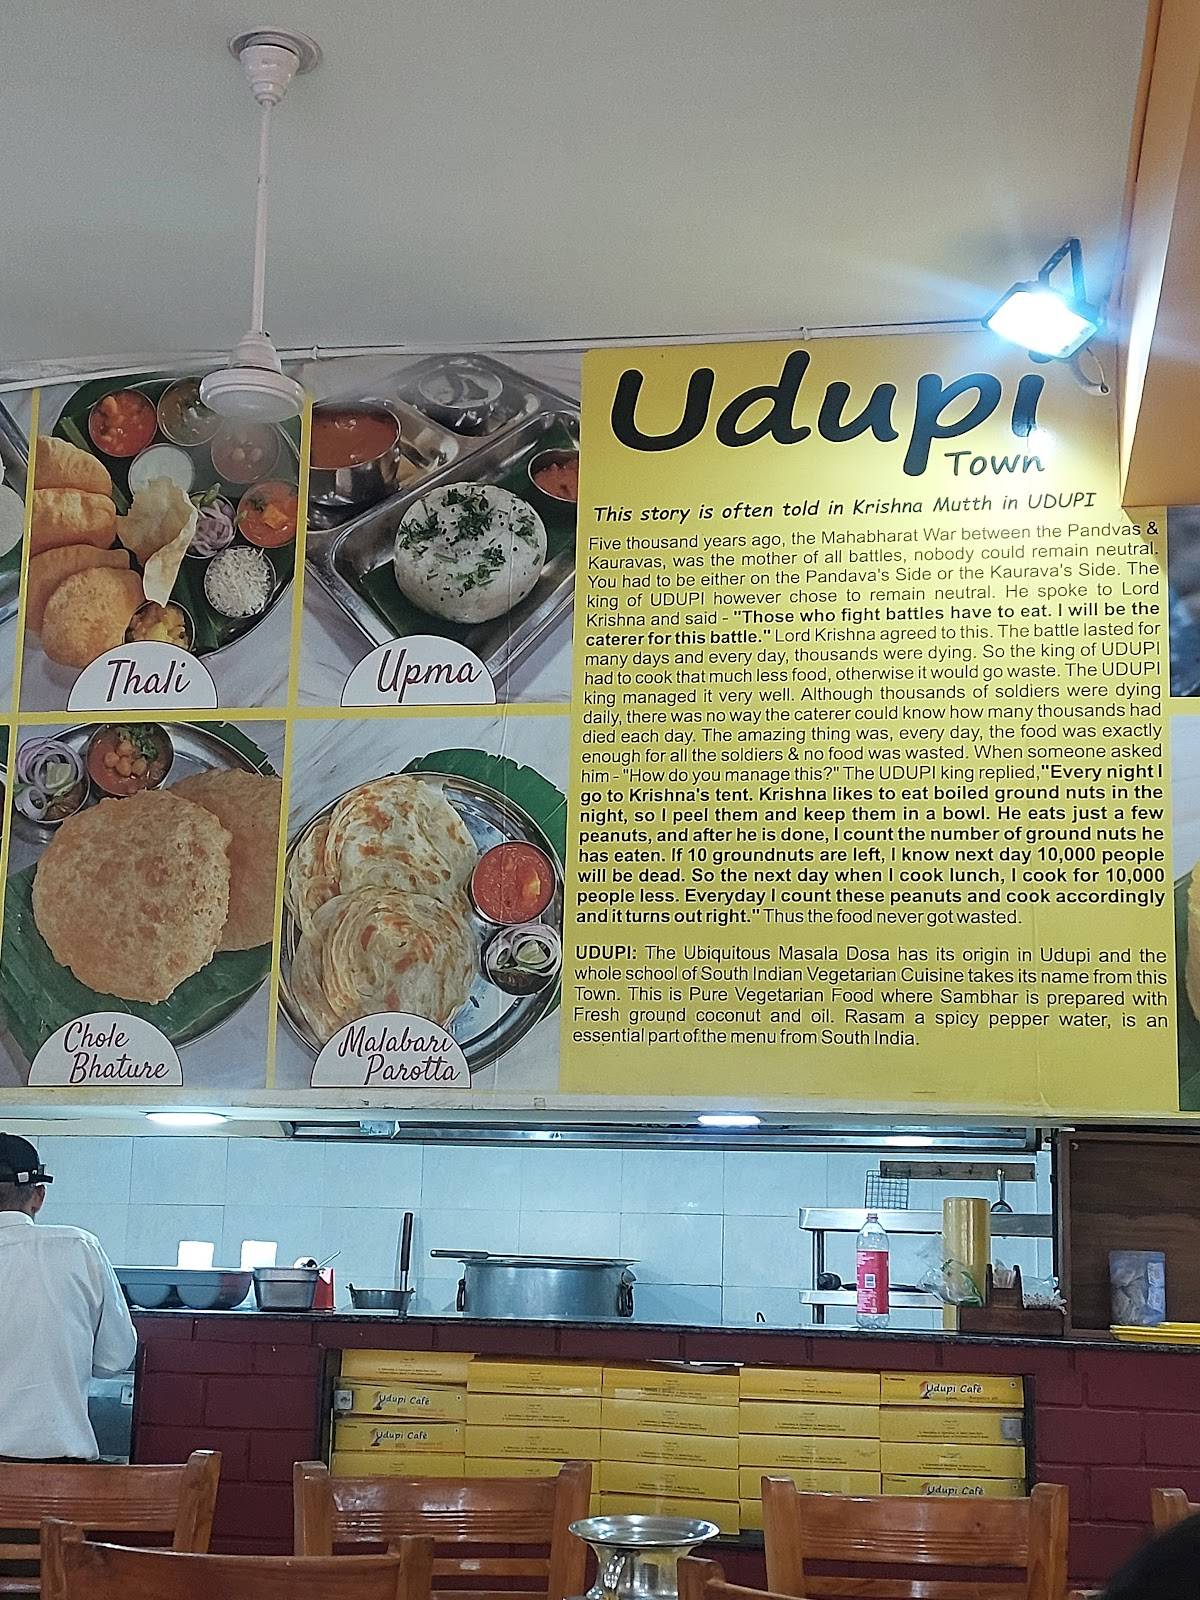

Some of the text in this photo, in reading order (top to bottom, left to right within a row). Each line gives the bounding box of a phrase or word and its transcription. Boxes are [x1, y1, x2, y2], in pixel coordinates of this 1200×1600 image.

[611, 349, 1049, 476] Udupi
[944, 450, 1045, 476] Town
[594, 492, 1097, 525] This story is often told in Krishna Mutth in UDUPI
[589, 521, 1159, 551] Five thousand years ago, the Mahabharat War between the Pandvas &
[588, 541, 1158, 570] Kauravas, was the mother of all battles, nobody could remain neutral.
[587, 580, 1159, 611] king of UDUPI however chose to remain neutral. He spoke to Lord
[585, 641, 1160, 669] many days and every day, thousands were dying. So the king of UDUPI
[106, 658, 190, 702] Thali
[376, 648, 482, 704] Upma
[584, 682, 1161, 708] king managed it very well. Although thousands of soldiers were dying
[580, 784, 1163, 806] go to Krishna's tent. Krishna likes to eat boiled ground nuts in the
[579, 848, 608, 862] has
[614, 848, 666, 862] eaten.
[672, 847, 683, 862] If
[688, 848, 707, 862] 10
[712, 848, 814, 865] groundnuts
[820, 850, 847, 862] are
[853, 847, 885, 864] left,
[902, 847, 950, 861] know
[955, 848, 994, 861] next
[999, 847, 1032, 865] day
[1038, 847, 1096, 864] 10,000
[1102, 847, 1164, 865] people
[577, 888, 635, 906] people
[640, 888, 679, 902] less.
[685, 888, 766, 906] Everyday
[781, 889, 832, 902] count
[836, 888, 884, 903] these
[890, 889, 962, 906] peanuts
[967, 888, 1000, 903] and
[1006, 888, 1051, 903] cook
[1056, 889, 1165, 907] accordingly
[576, 945, 1167, 966] UDUPI: The Ubiquitous Masala Dosa has its origin in Udupi and the
[574, 986, 1167, 1009] Town. This is Pure Vegetarian Food where Sambhar is prepared with
[63, 1021, 130, 1052] Chole
[338, 1025, 452, 1058] Malabari
[573, 1027, 919, 1046] essential part of the menu from South India.
[69, 1053, 169, 1084] Bhature
[364, 1053, 460, 1086] Parotta
[378, 1394, 406, 1405] Udupi
[926, 1383, 956, 1394] Udupi
[375, 1431, 403, 1440] Udupi
[927, 1485, 957, 1496] Udupi
